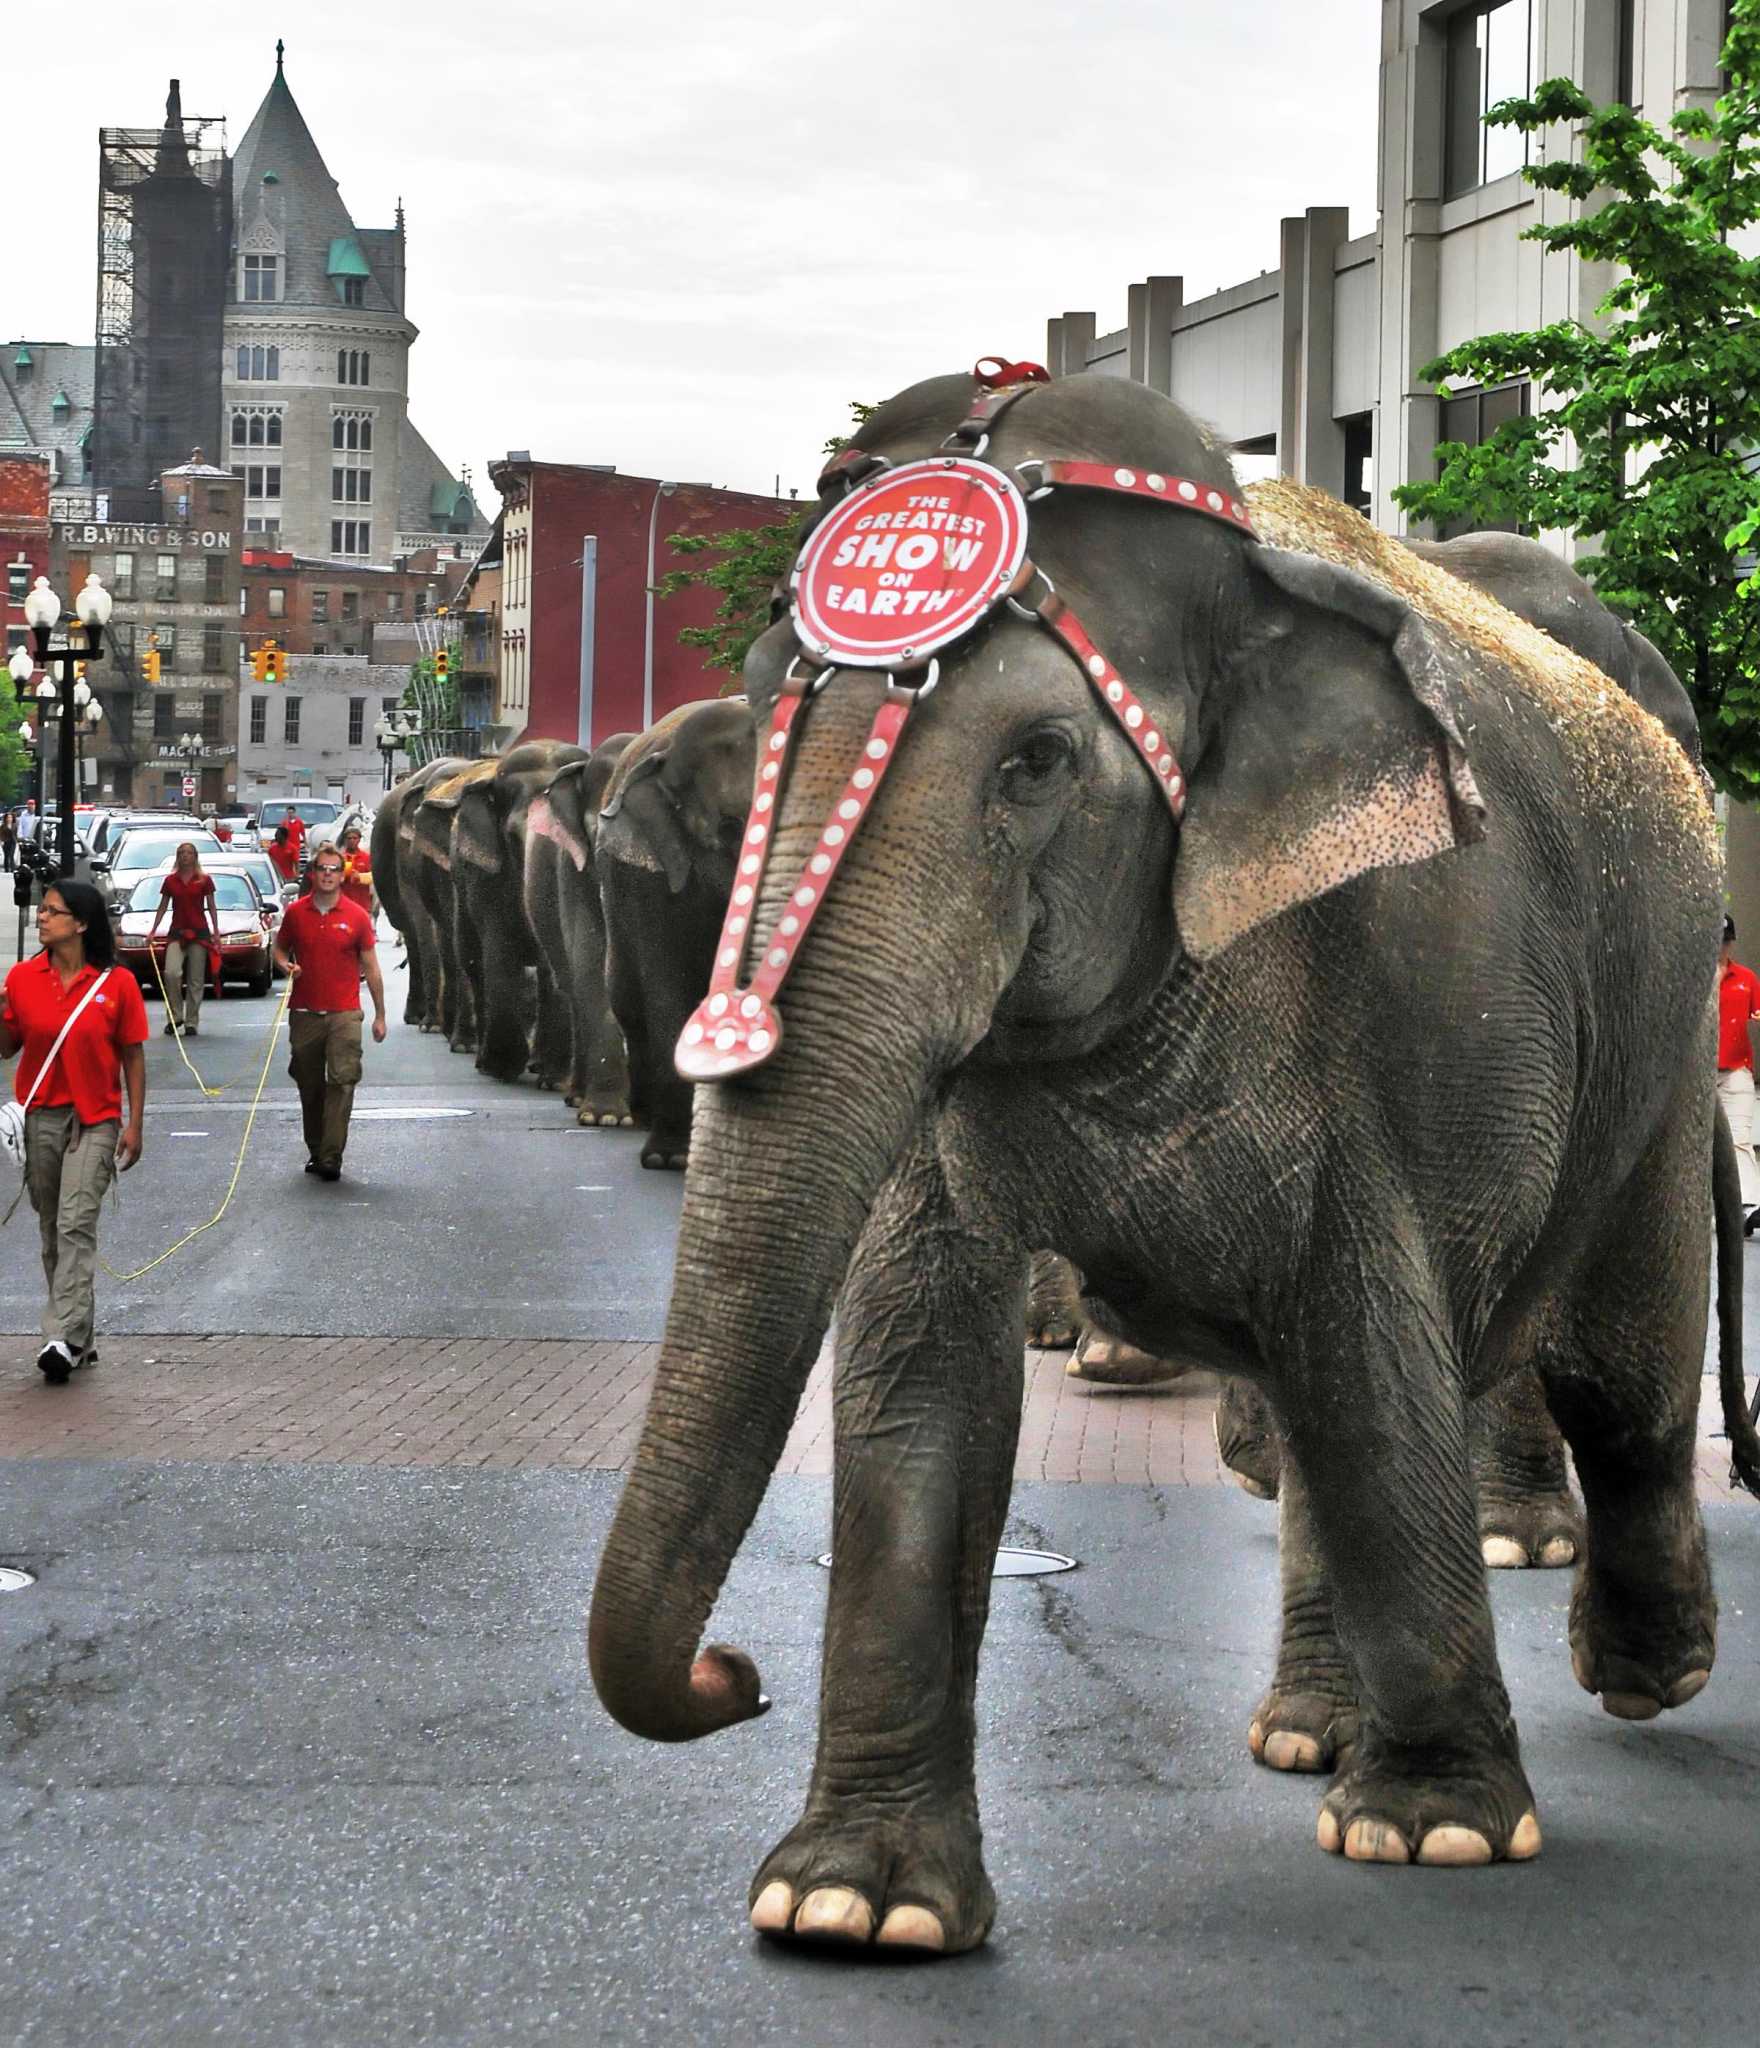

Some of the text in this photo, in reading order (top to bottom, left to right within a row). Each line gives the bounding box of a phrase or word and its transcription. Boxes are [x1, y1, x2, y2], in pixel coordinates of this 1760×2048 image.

[907, 496, 950, 509] THE
[855, 511, 986, 536] GREATEST
[167, 528, 183, 546] &
[187, 530, 231, 548] SON
[832, 534, 984, 572] SHOW
[878, 572, 914, 588] ON
[825, 585, 956, 616] EARTH
